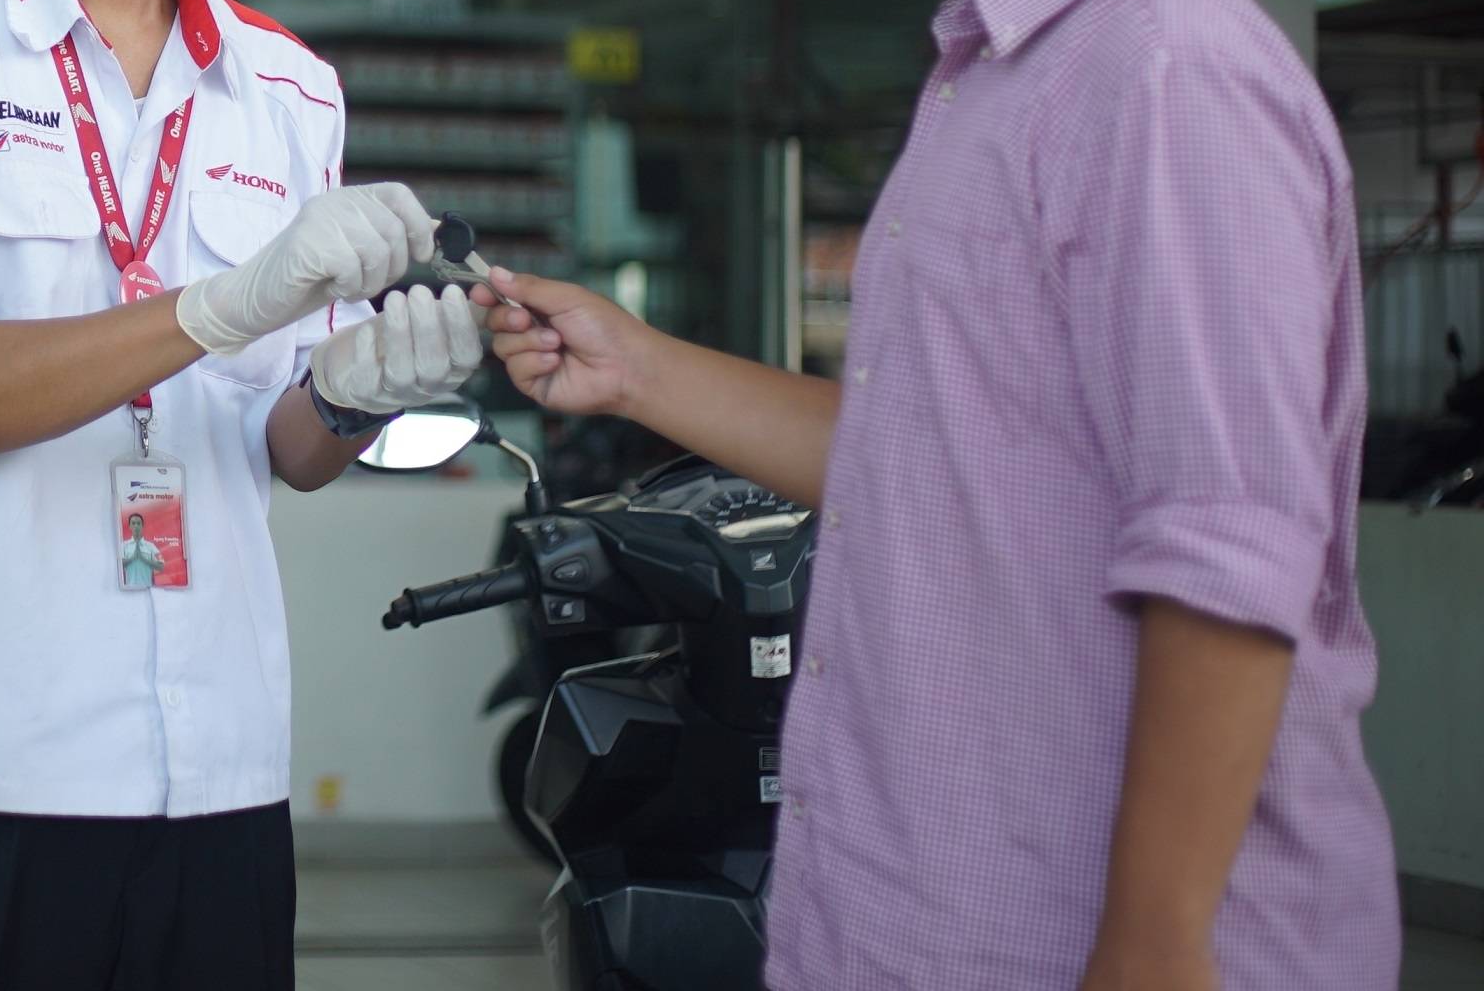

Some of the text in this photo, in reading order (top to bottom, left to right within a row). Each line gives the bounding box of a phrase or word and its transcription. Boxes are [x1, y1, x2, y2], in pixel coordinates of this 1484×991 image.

[12, 132, 39, 147] astra
[91, 151, 117, 214] One HEART.
[143, 226, 155, 248] One
